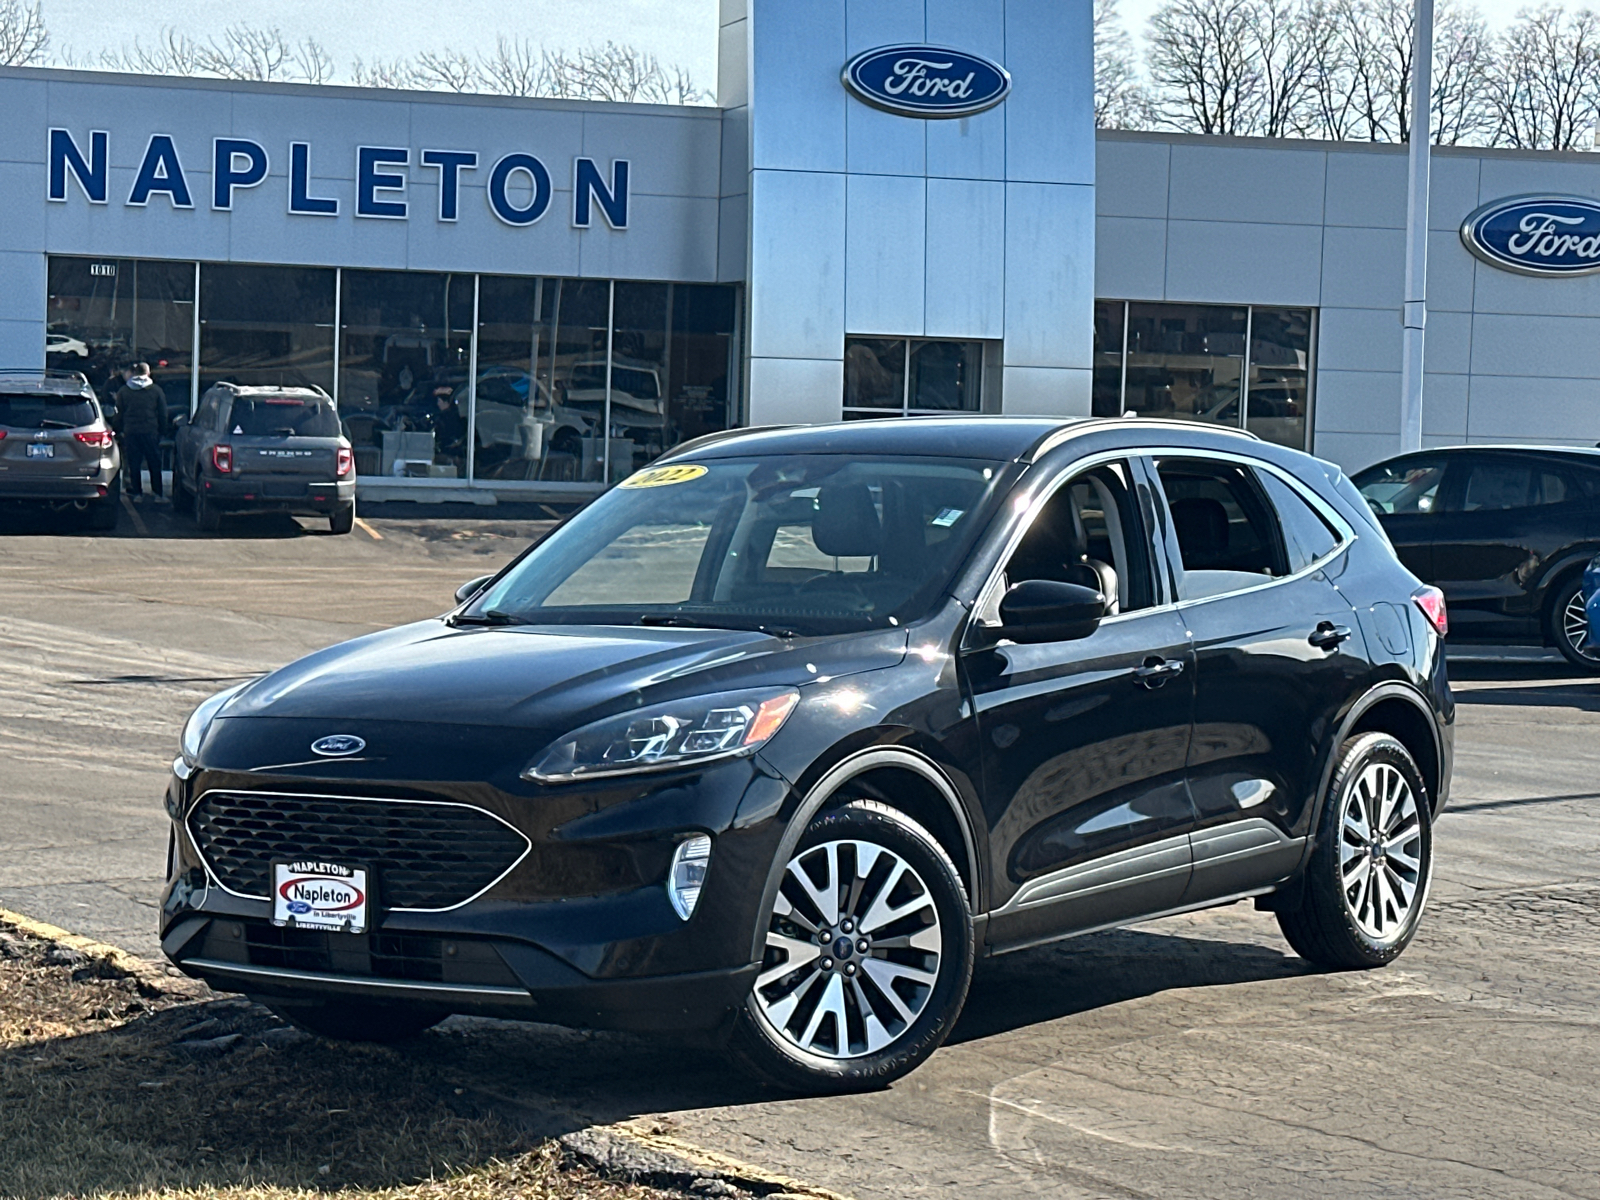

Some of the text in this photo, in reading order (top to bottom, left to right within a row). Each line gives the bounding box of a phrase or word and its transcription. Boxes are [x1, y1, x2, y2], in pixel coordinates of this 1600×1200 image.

[884, 58, 975, 99] Ford
[47, 127, 631, 230] NAPLETON
[91, 264, 116, 276] 1010
[293, 861, 346, 876] NAPLETON
[294, 883, 351, 905] Napleton
